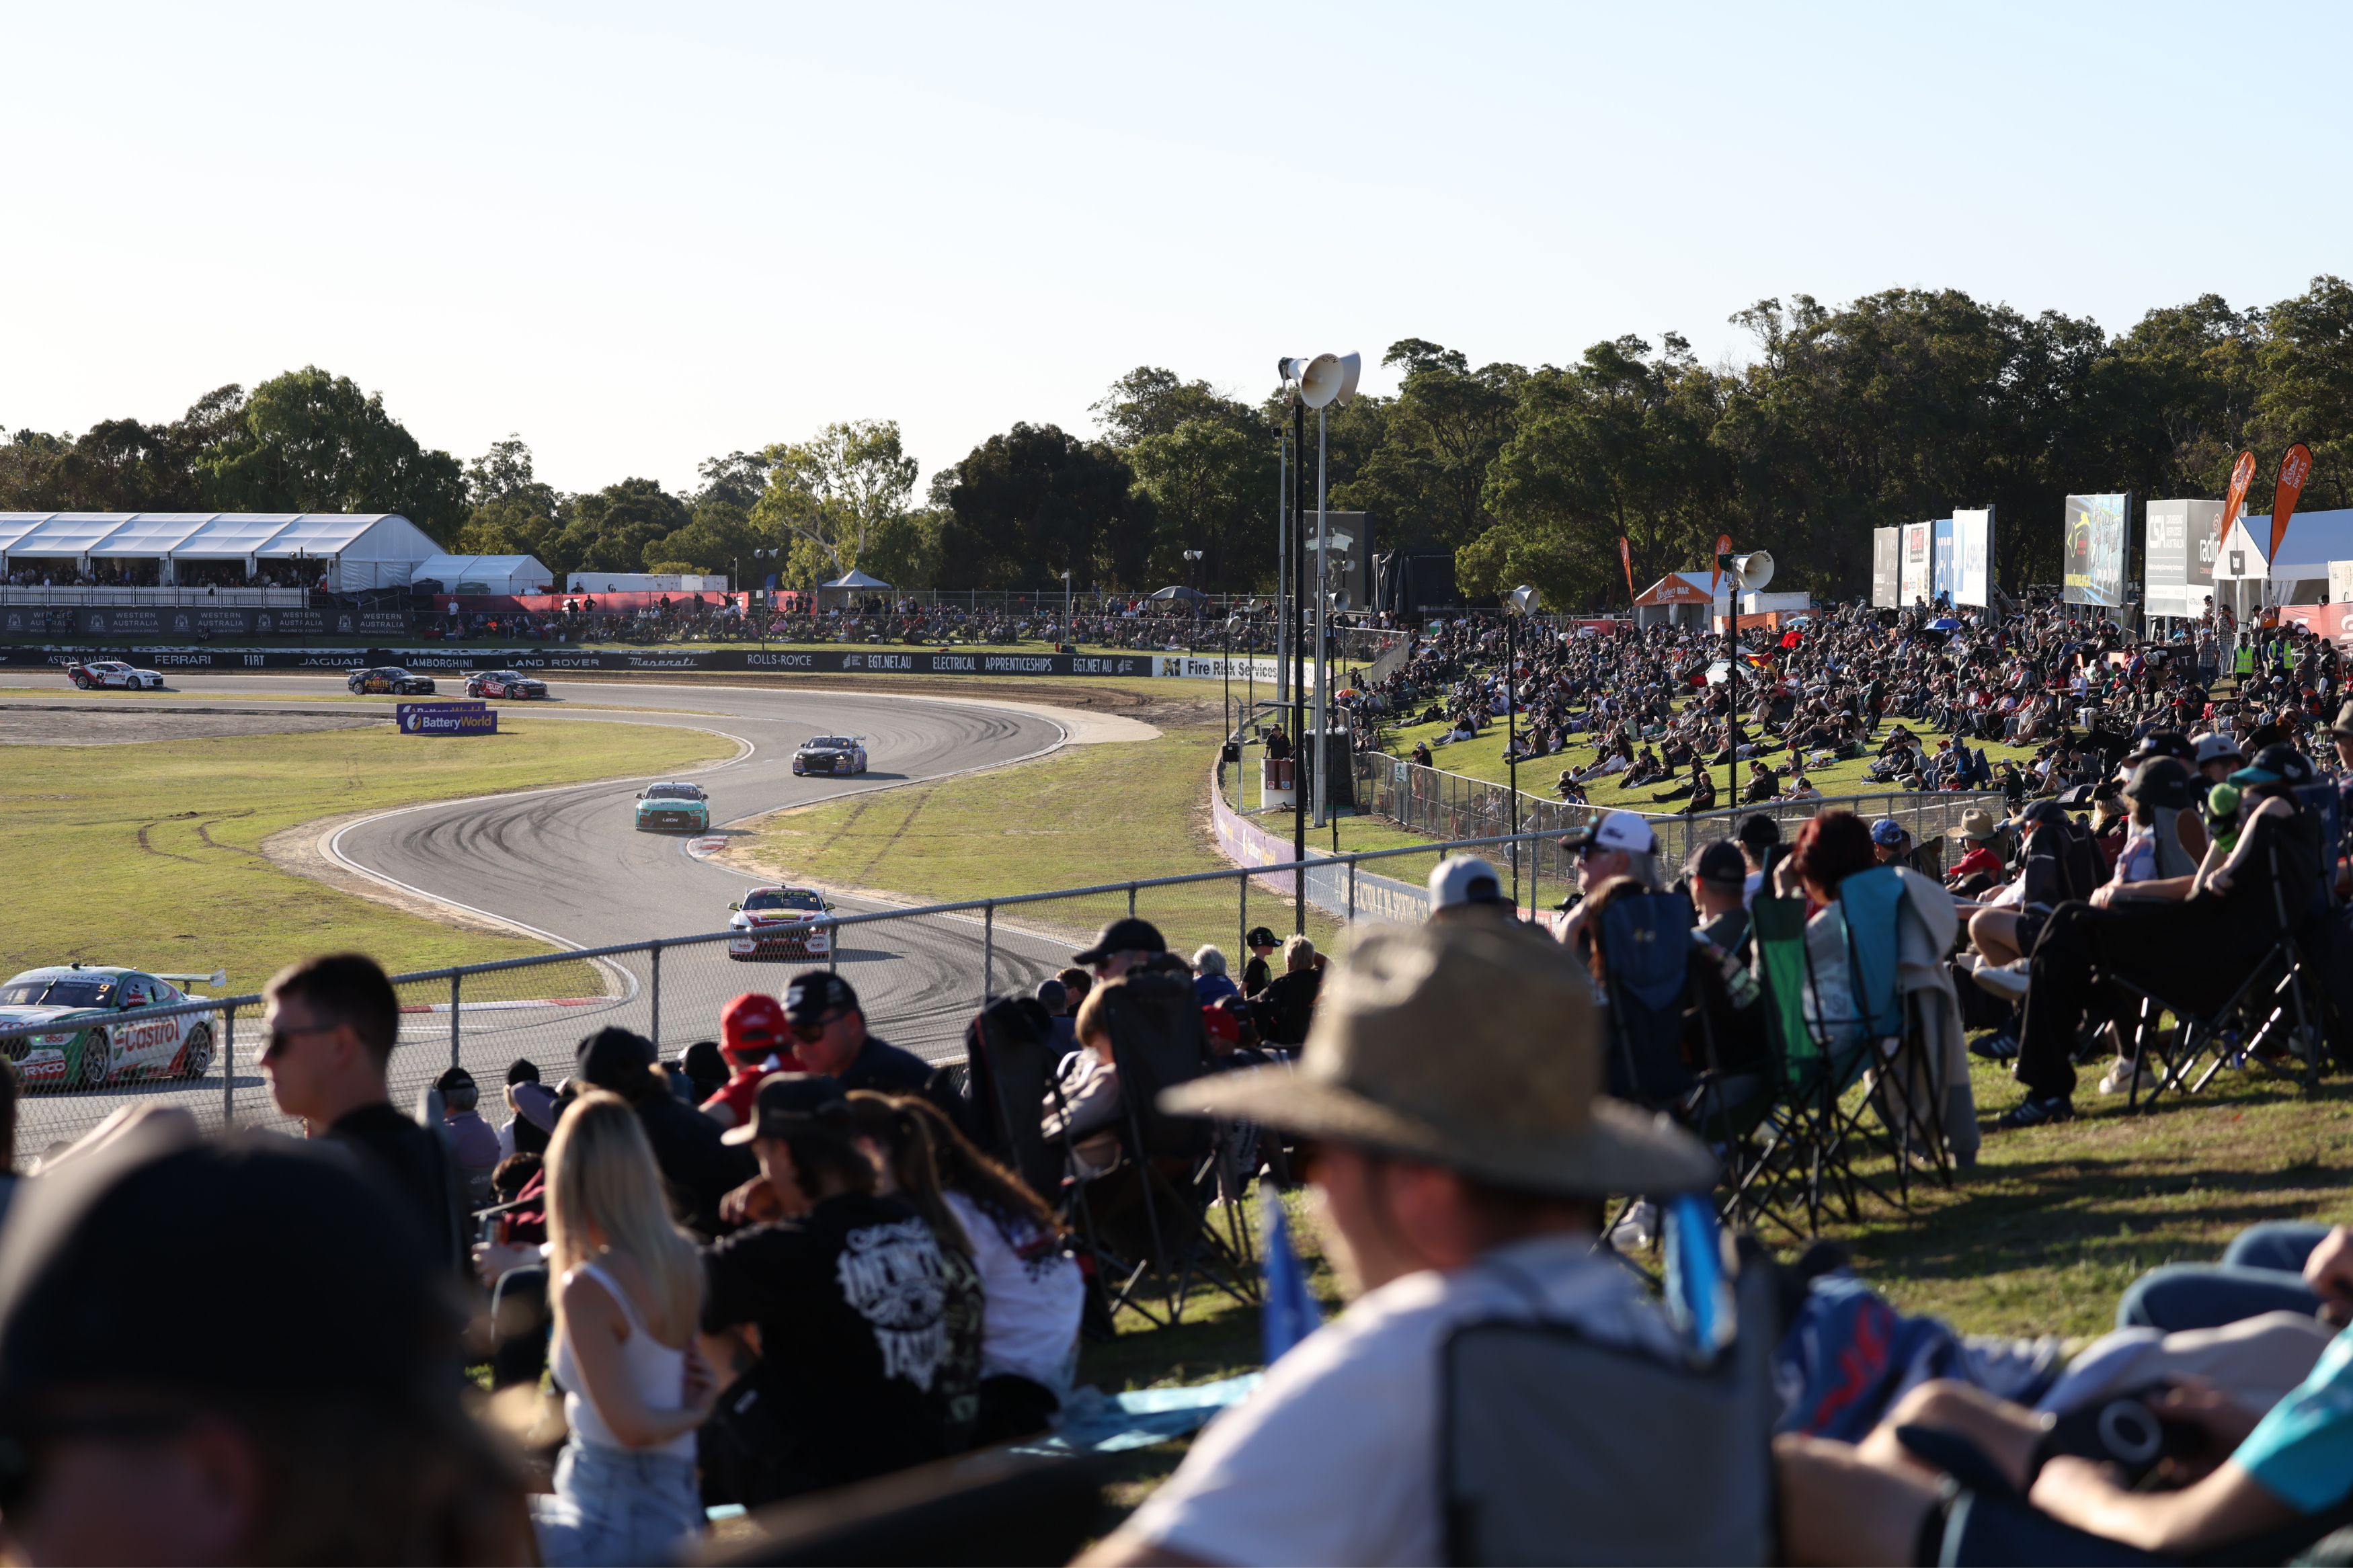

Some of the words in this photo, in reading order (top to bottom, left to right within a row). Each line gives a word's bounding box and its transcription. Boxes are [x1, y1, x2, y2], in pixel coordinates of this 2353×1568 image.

[2292, 474, 2303, 489] DRY
[2148, 515, 2166, 548] CSA
[2166, 526, 2182, 536] SERVICES
[2165, 538, 2184, 549] AUSTRALIA
[1677, 586, 1689, 595] BAR
[48, 655, 80, 664] ASTON
[83, 655, 121, 665] MARTIN
[155, 655, 211, 665] FERRARI
[243, 655, 264, 666] FIAT
[406, 658, 473, 668] LAMBORGHINI
[506, 659, 545, 667] LAND
[628, 657, 699, 667] Maserati
[747, 654, 811, 665] ROLLS-ROYCE
[868, 655, 912, 669] EGT.NET.AU
[932, 656, 976, 670] ELECTRICAL
[985, 657, 1052, 671] APPRENTICESHIPS
[1187, 660, 1210, 675] Fire
[1238, 661, 1277, 678] Services
[365, 679, 389, 688] PENRITE
[486, 683, 505, 692] ISUZU
[423, 715, 492, 730] BatteryWorld
[63, 975, 116, 983] TRUCKS
[97, 984, 110, 992] 9
[46, 1034, 64, 1042] dba
[125, 1015, 180, 1052] Castrol
[24, 1062, 65, 1076] RYCO
